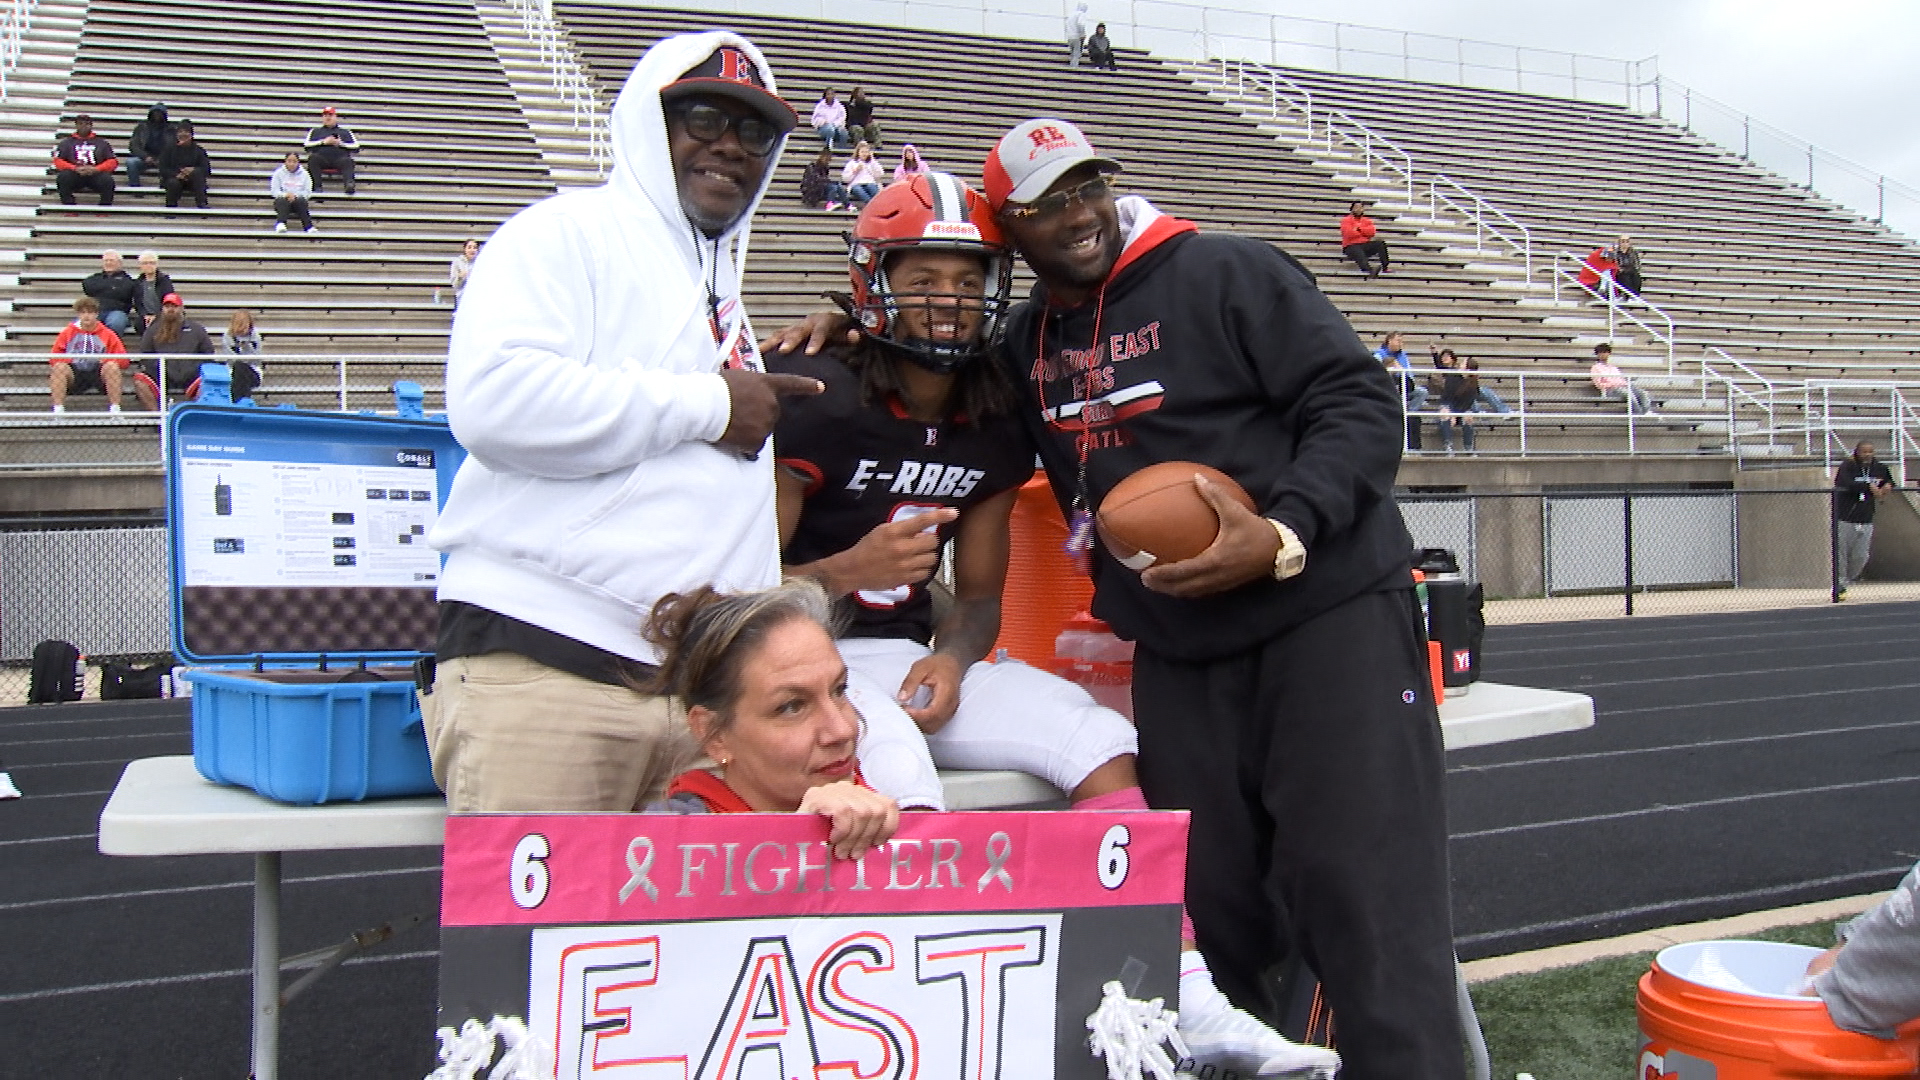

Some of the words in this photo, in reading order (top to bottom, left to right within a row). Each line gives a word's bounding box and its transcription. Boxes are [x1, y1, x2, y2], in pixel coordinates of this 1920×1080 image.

[1027, 126, 1066, 147] RE
[931, 224, 975, 236] Riddell
[1110, 320, 1161, 362] EAST
[845, 459, 986, 498] E-RABS
[509, 833, 551, 909] 6
[675, 838, 965, 898] FIGHTER
[1099, 824, 1131, 889] 6
[553, 926, 1046, 1080] EAST
